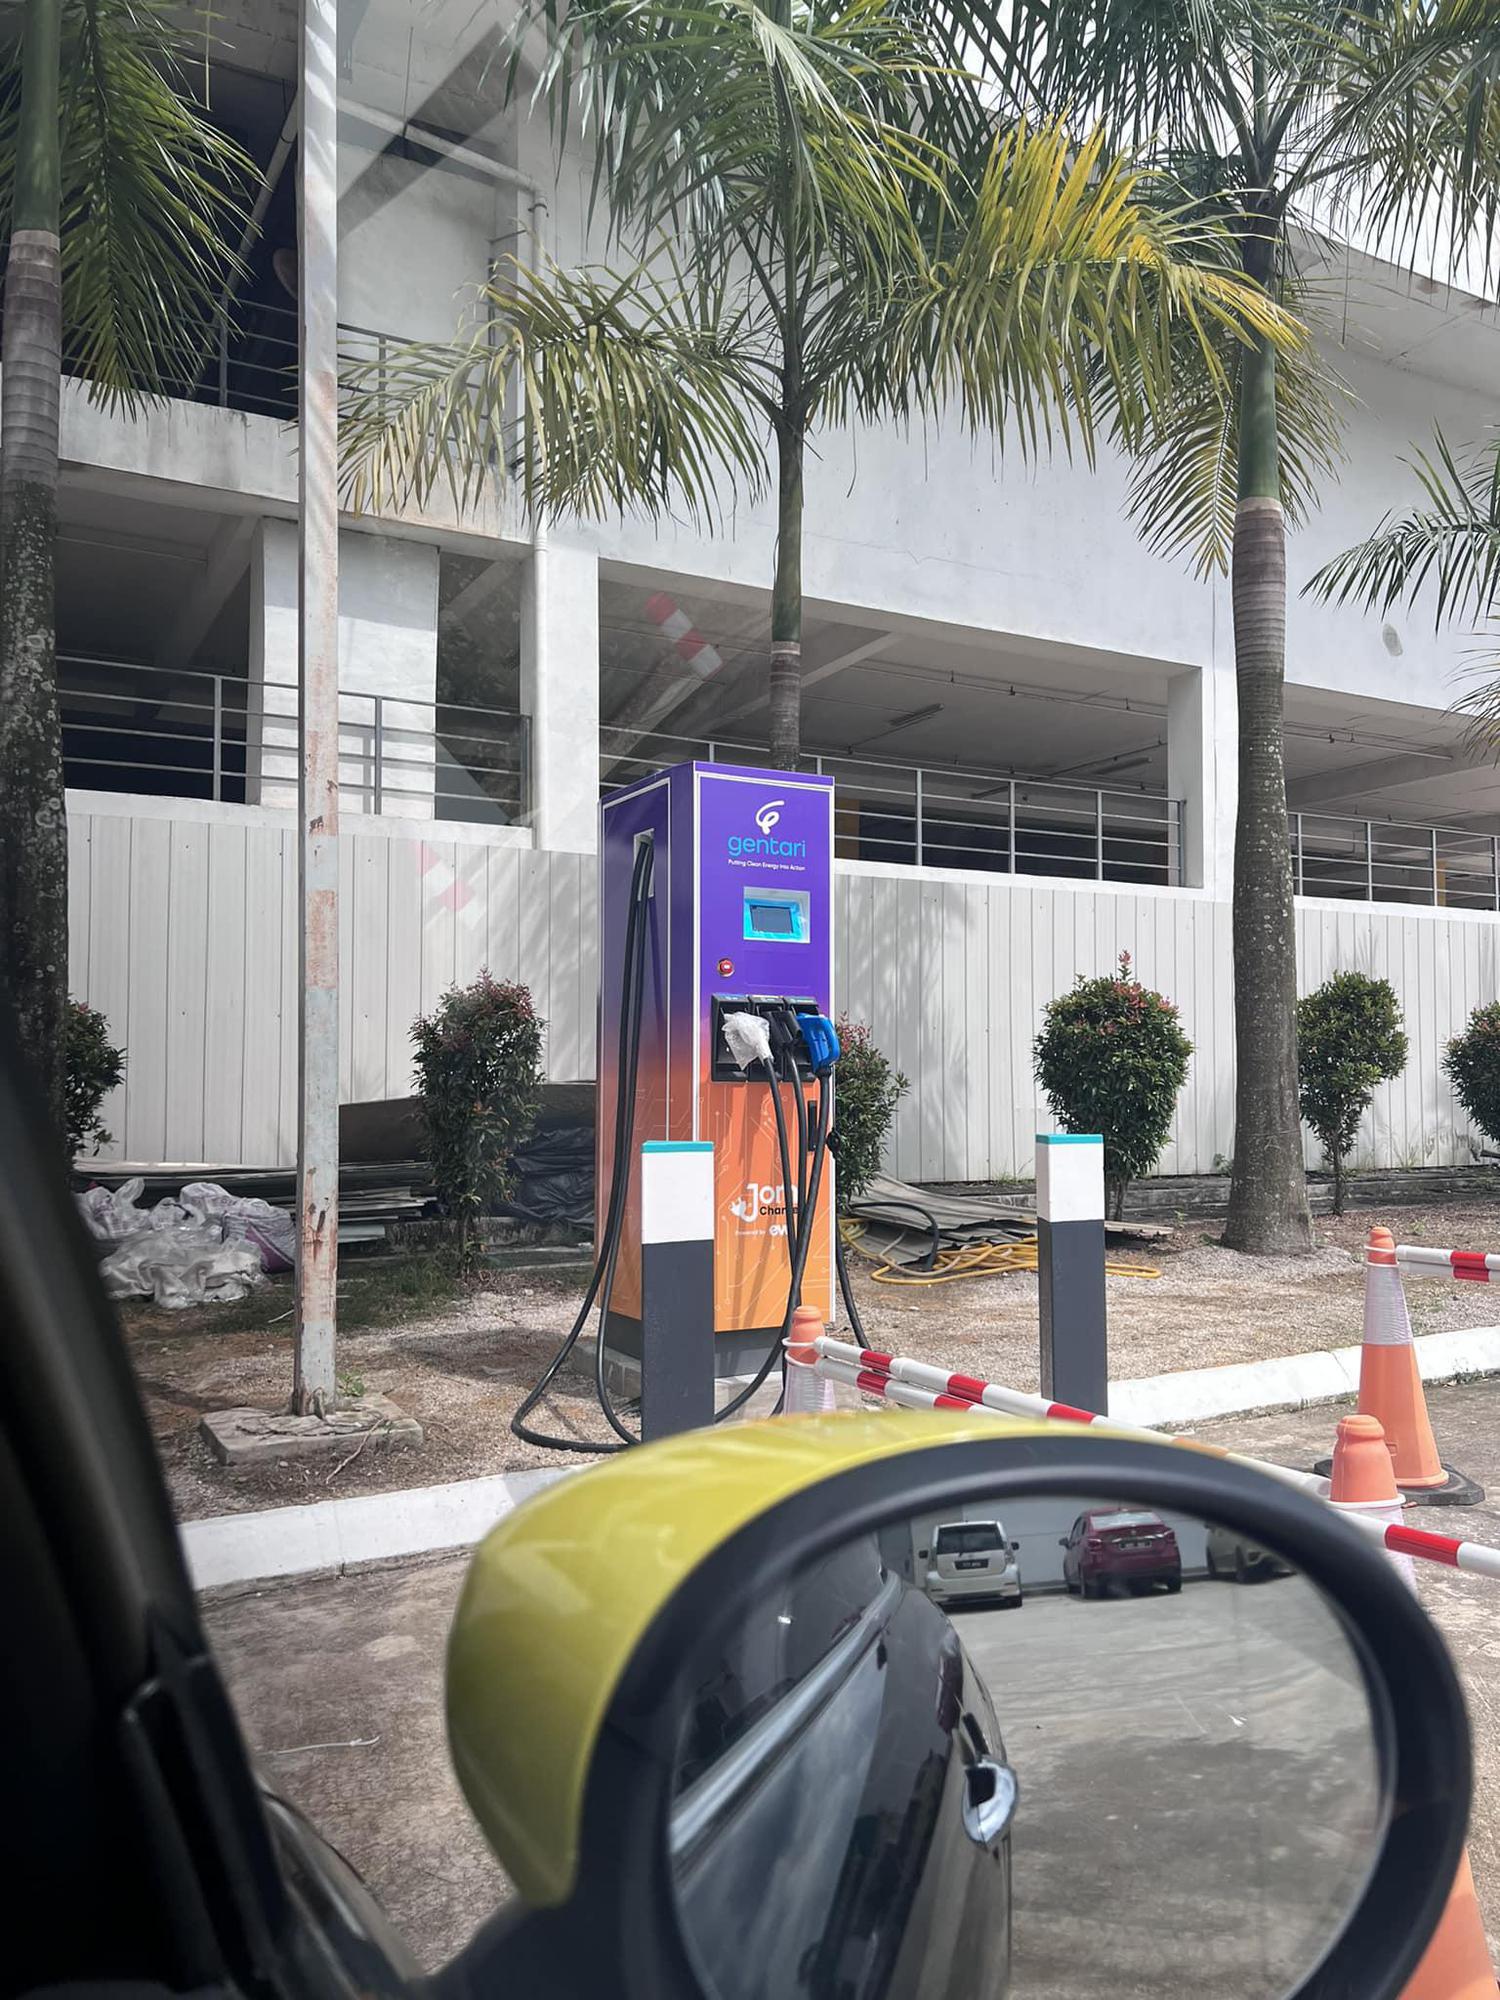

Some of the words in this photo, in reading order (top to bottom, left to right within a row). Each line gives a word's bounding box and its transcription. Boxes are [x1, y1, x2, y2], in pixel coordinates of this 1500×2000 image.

[727, 836, 806, 858] gentari
[728, 859, 746, 868] Putting
[747, 860, 761, 868] Clean
[762, 861, 779, 870] Energy
